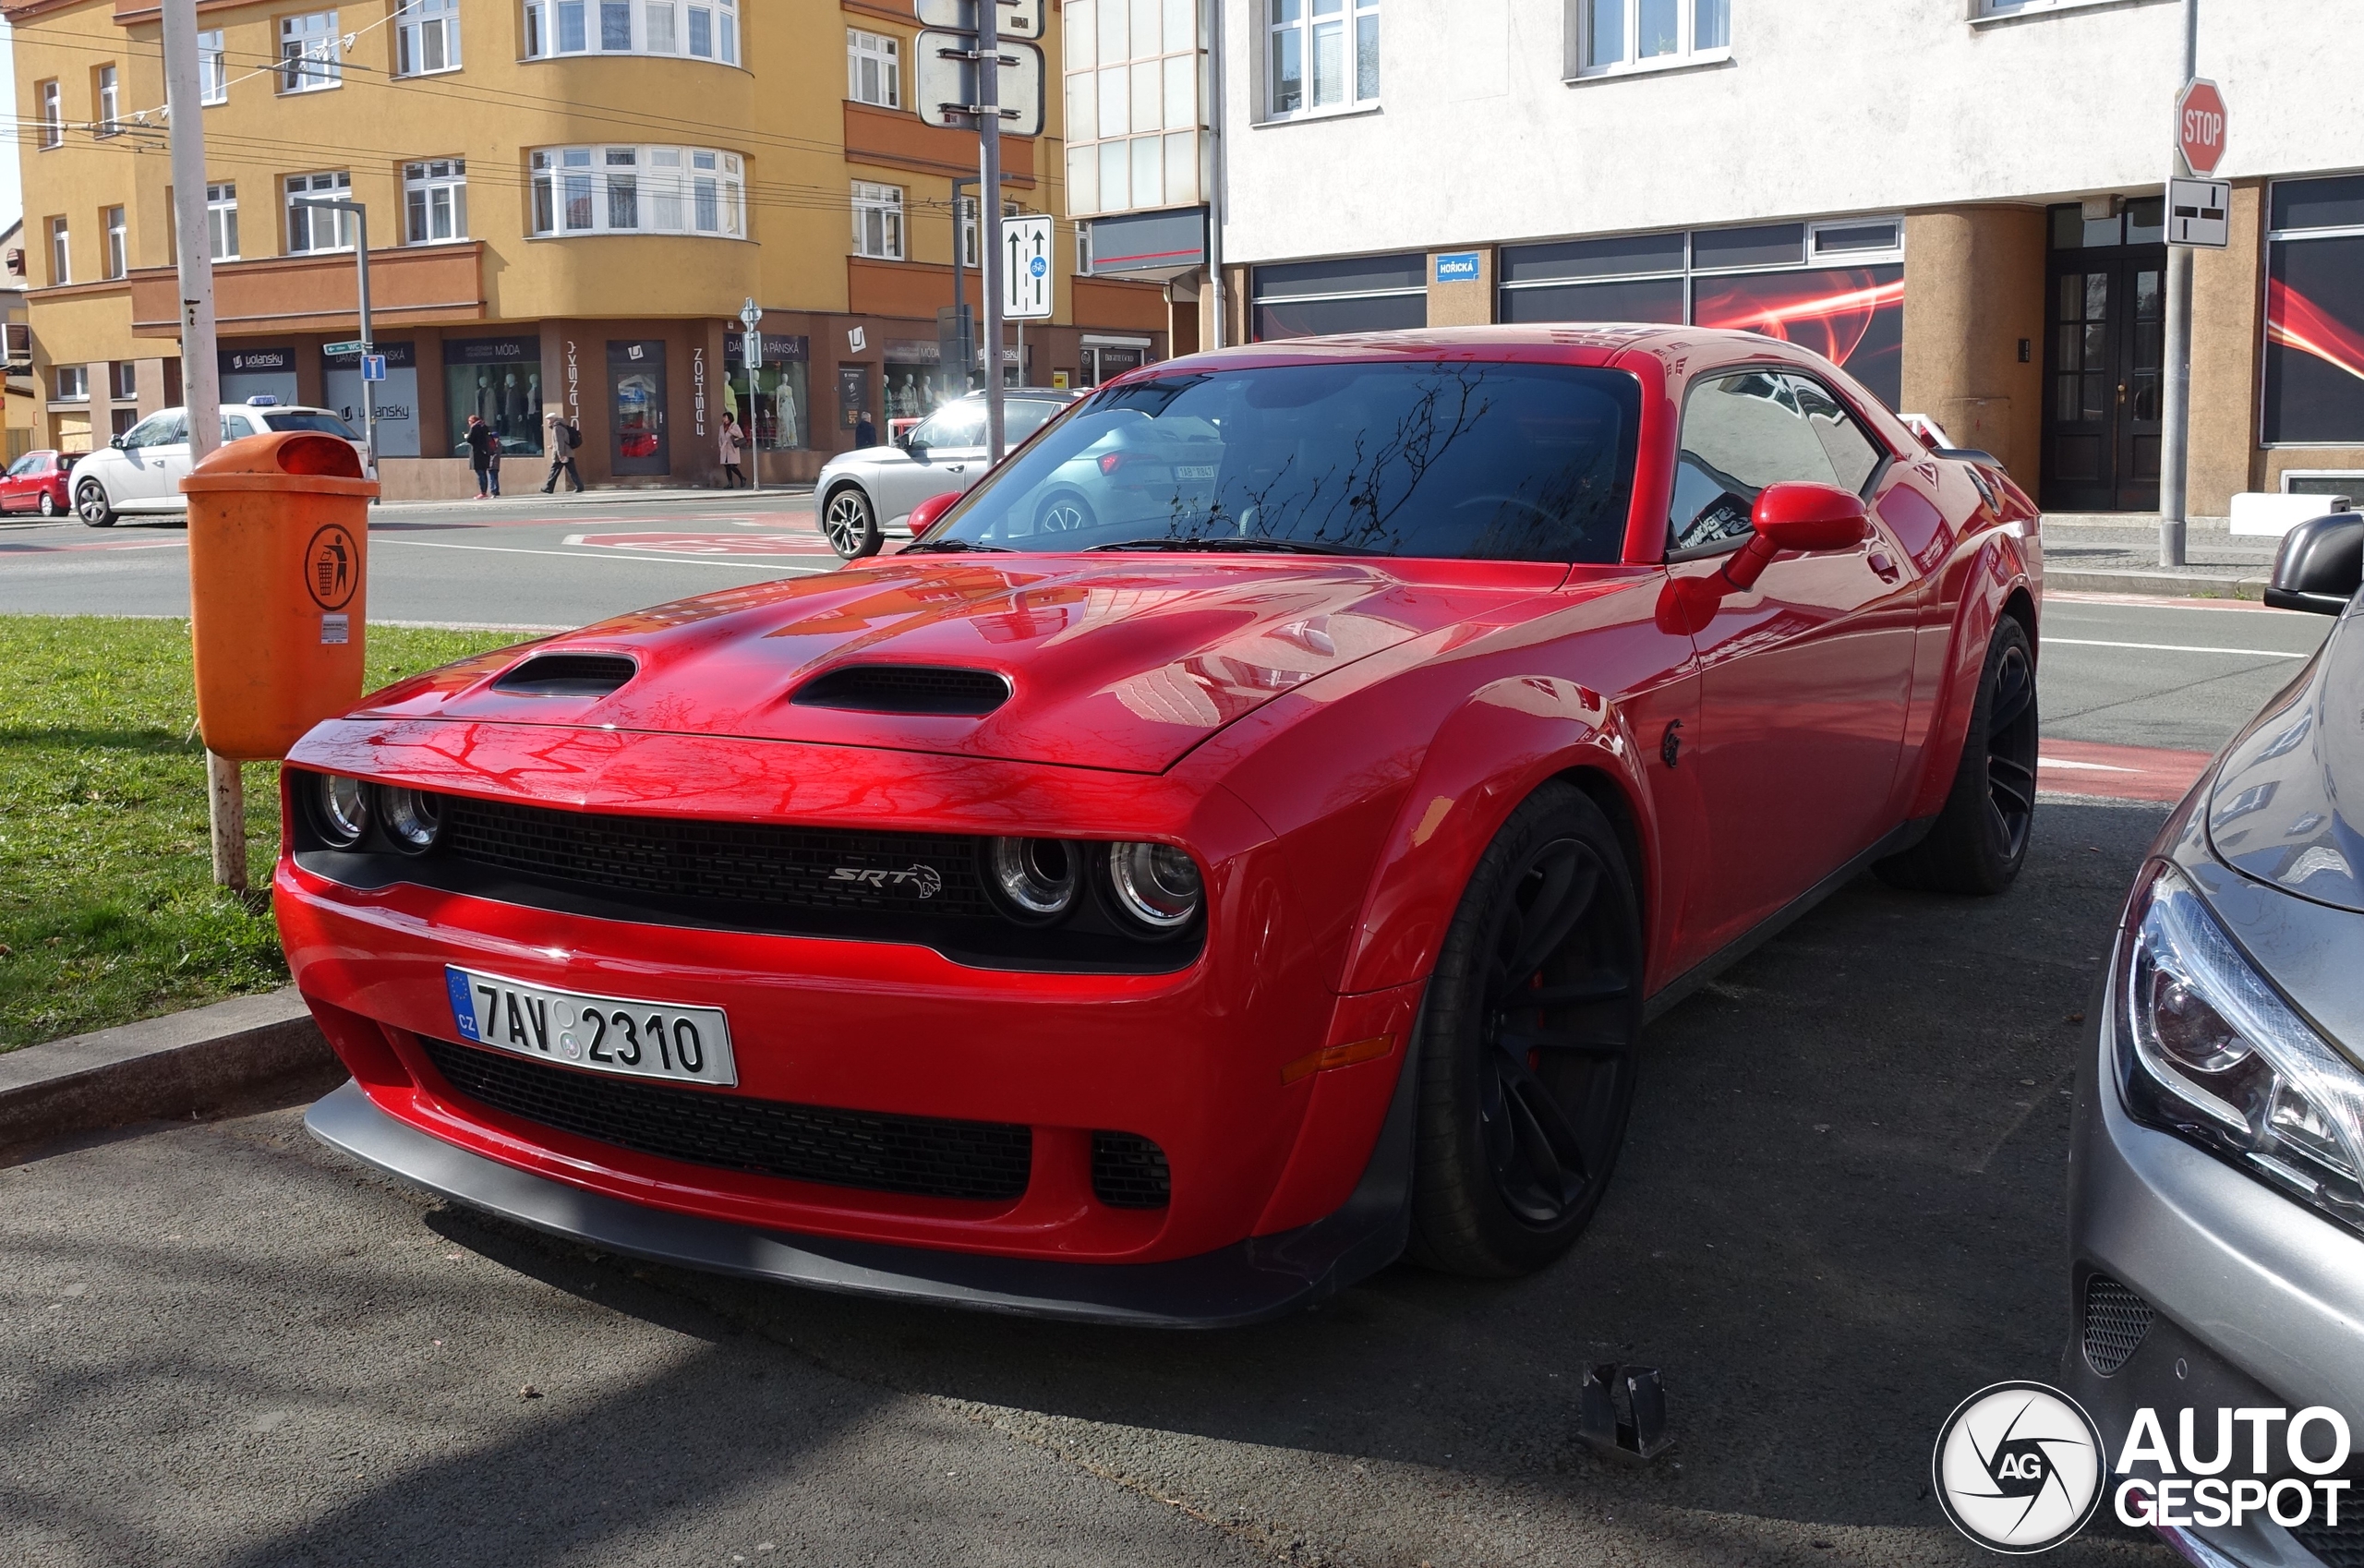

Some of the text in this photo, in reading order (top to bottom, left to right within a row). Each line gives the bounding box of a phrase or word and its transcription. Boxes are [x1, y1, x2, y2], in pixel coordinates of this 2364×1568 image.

[2185, 108, 2222, 147] STOP
[1441, 260, 1474, 274] HOŘICKÁ
[495, 344, 520, 356] MÓDA
[769, 342, 799, 354] PÁNSKÁ
[921, 346, 940, 358] MÓDA
[694, 348, 705, 437] FASHION
[828, 868, 918, 887] SRT
[459, 1013, 476, 1032] CZ
[476, 983, 705, 1073] 7AV 2310
